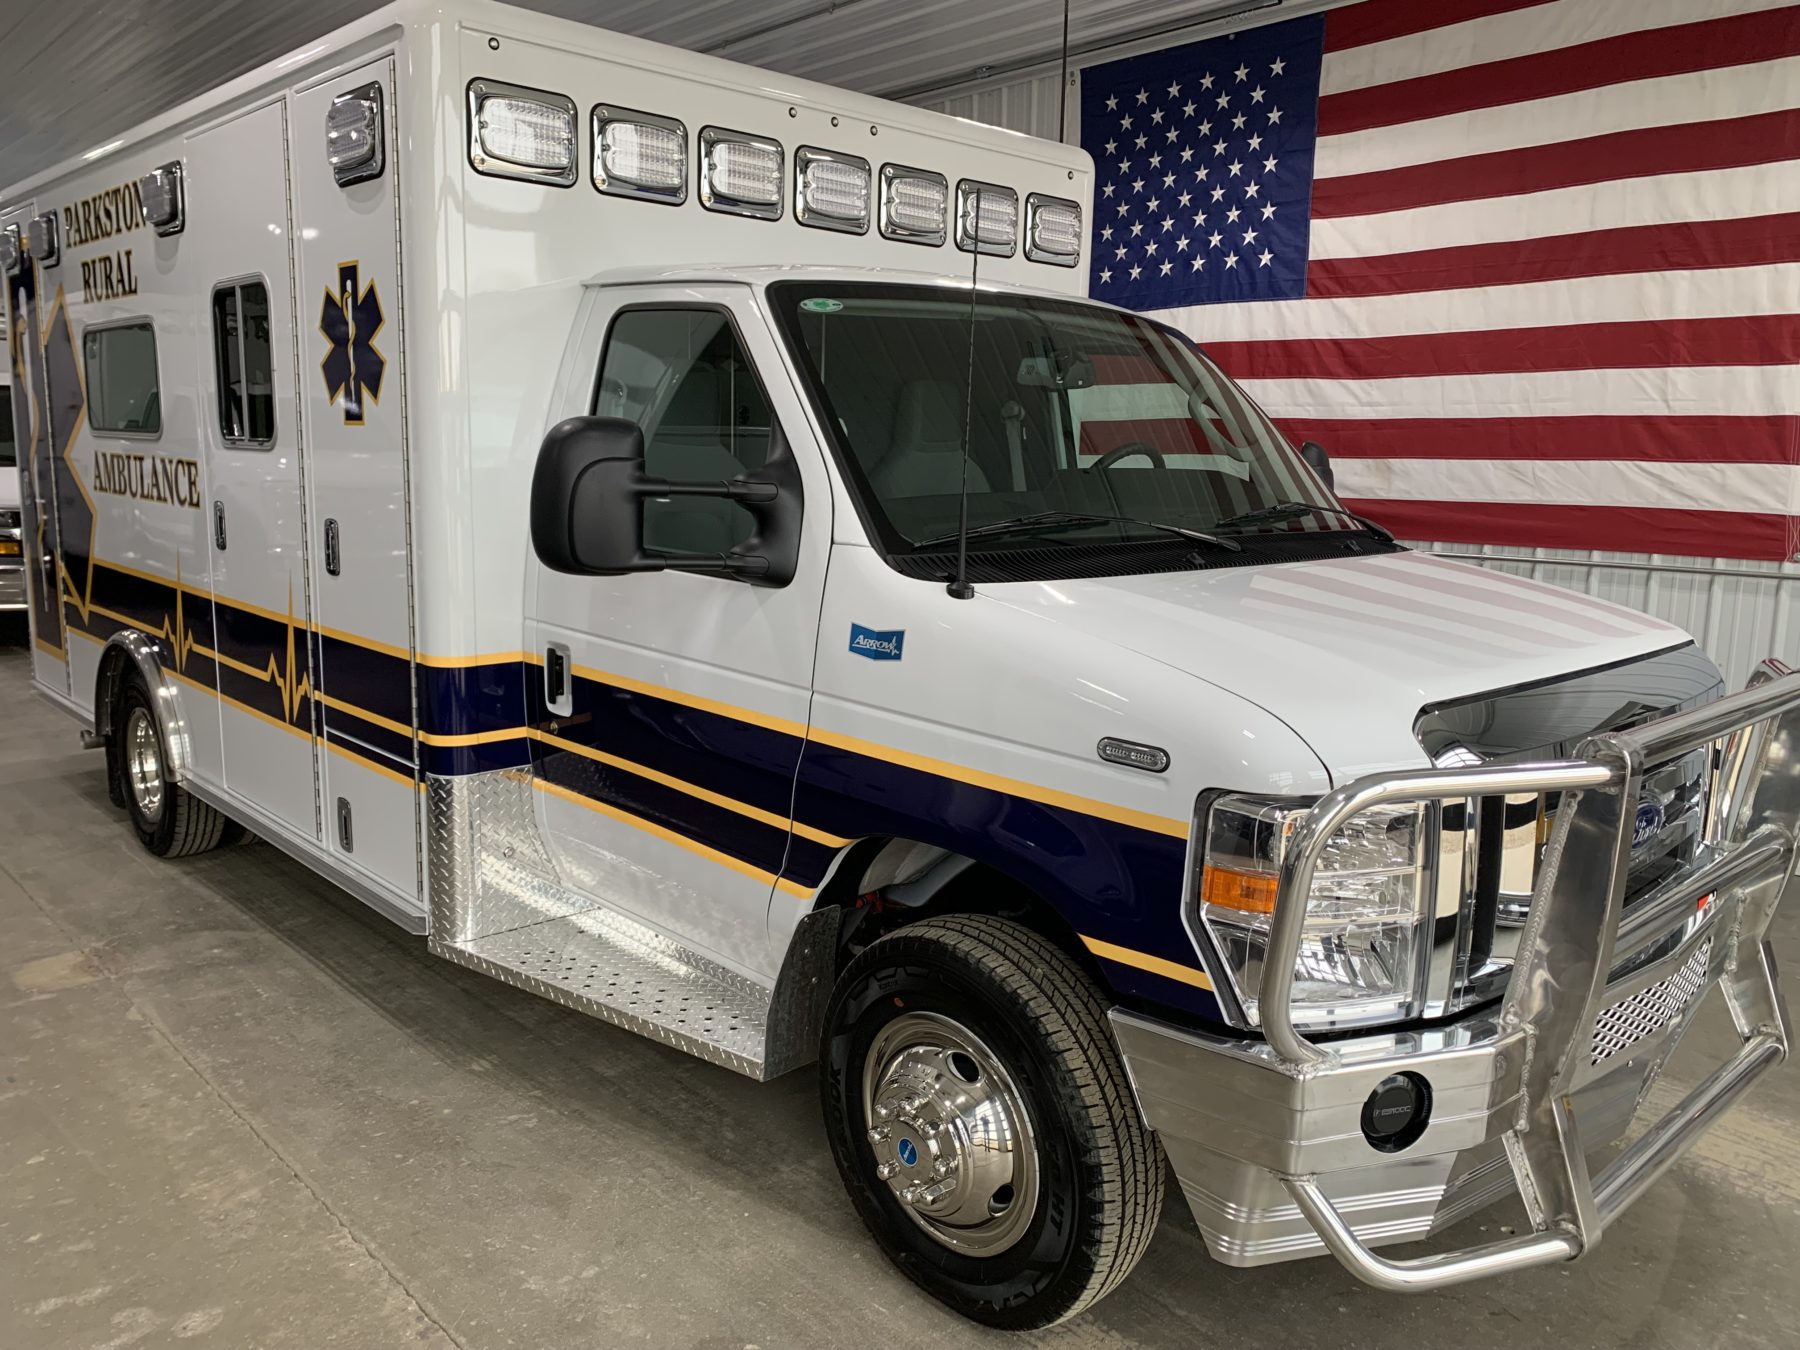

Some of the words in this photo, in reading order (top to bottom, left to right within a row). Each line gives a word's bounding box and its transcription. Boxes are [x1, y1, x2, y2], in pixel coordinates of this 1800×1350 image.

[63, 178, 146, 249] PARKSTON
[80, 250, 138, 304] RURAL
[93, 451, 200, 508] AMBULANCE
